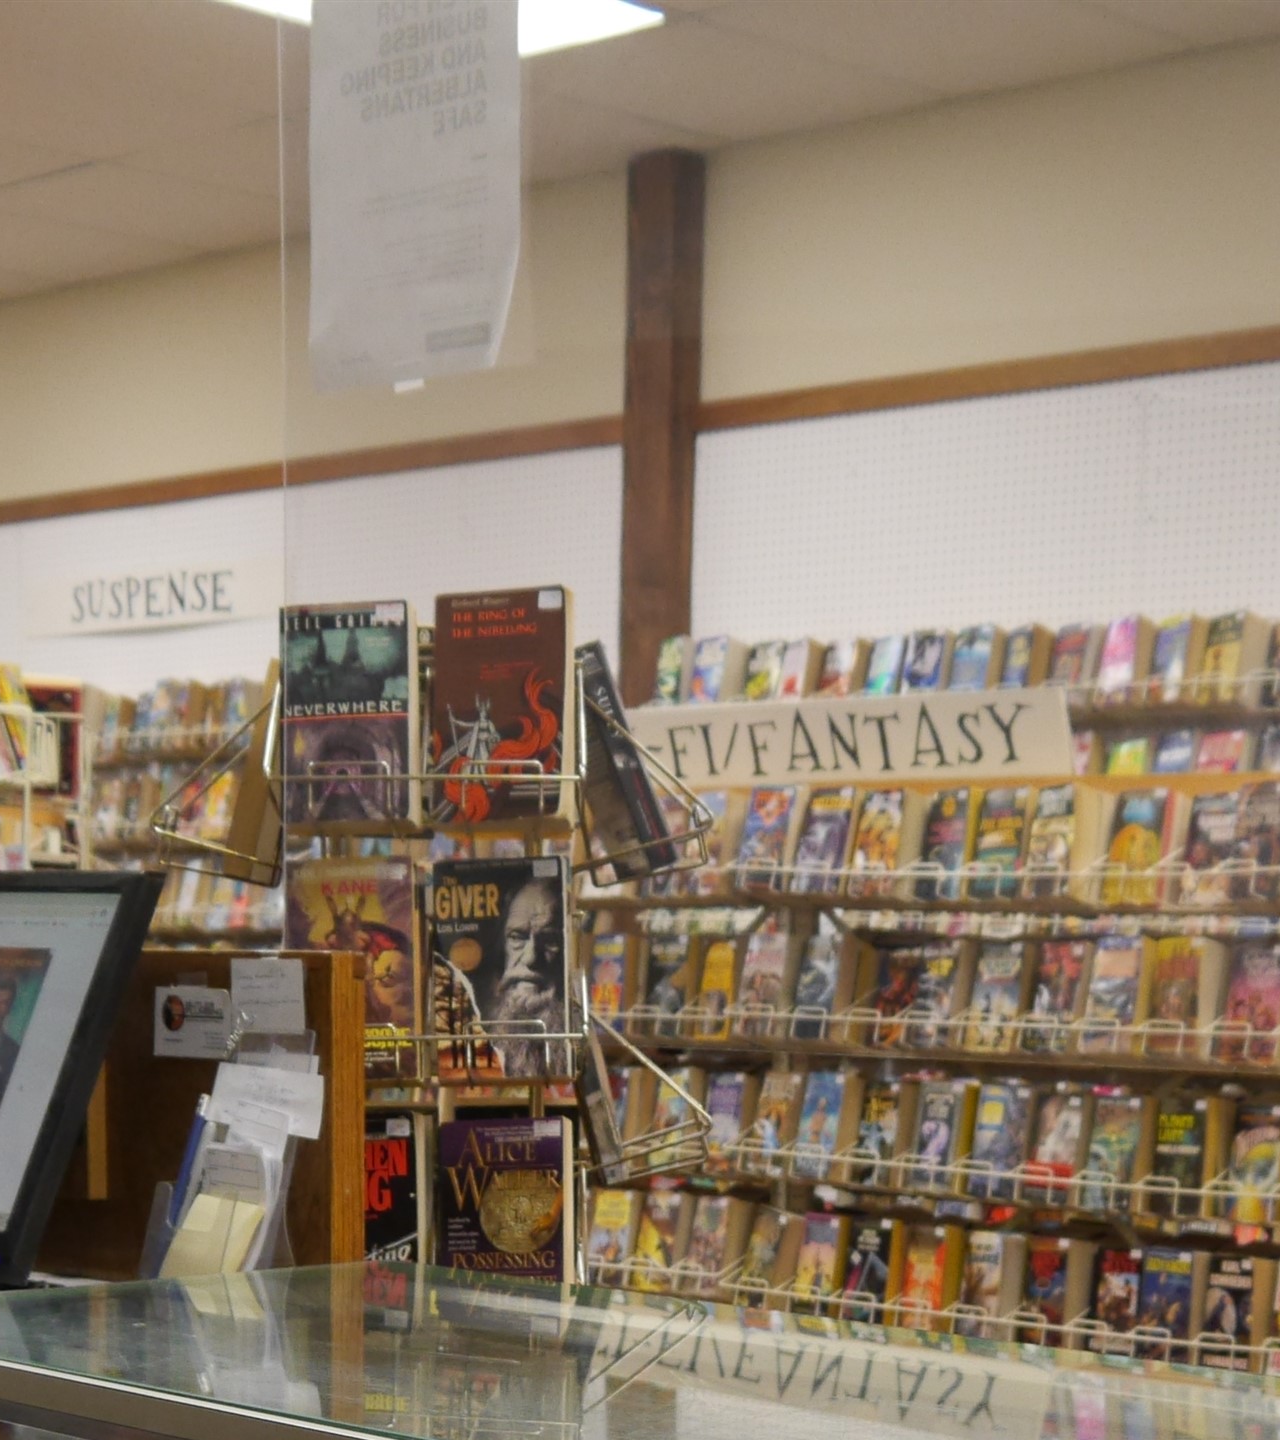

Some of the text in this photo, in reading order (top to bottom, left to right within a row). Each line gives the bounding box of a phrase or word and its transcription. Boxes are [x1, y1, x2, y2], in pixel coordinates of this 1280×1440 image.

[70, 570, 235, 623] SUSPENSE
[477, 609, 507, 622] RING
[511, 608, 527, 620] OF
[477, 623, 538, 637] NIBELUNG
[284, 700, 403, 718] NEVERWHERE
[320, 877, 378, 896] KANE
[434, 881, 501, 920] GIVER
[457, 1127, 537, 1169] ALICE
[451, 1250, 556, 1270] POSSESSING
